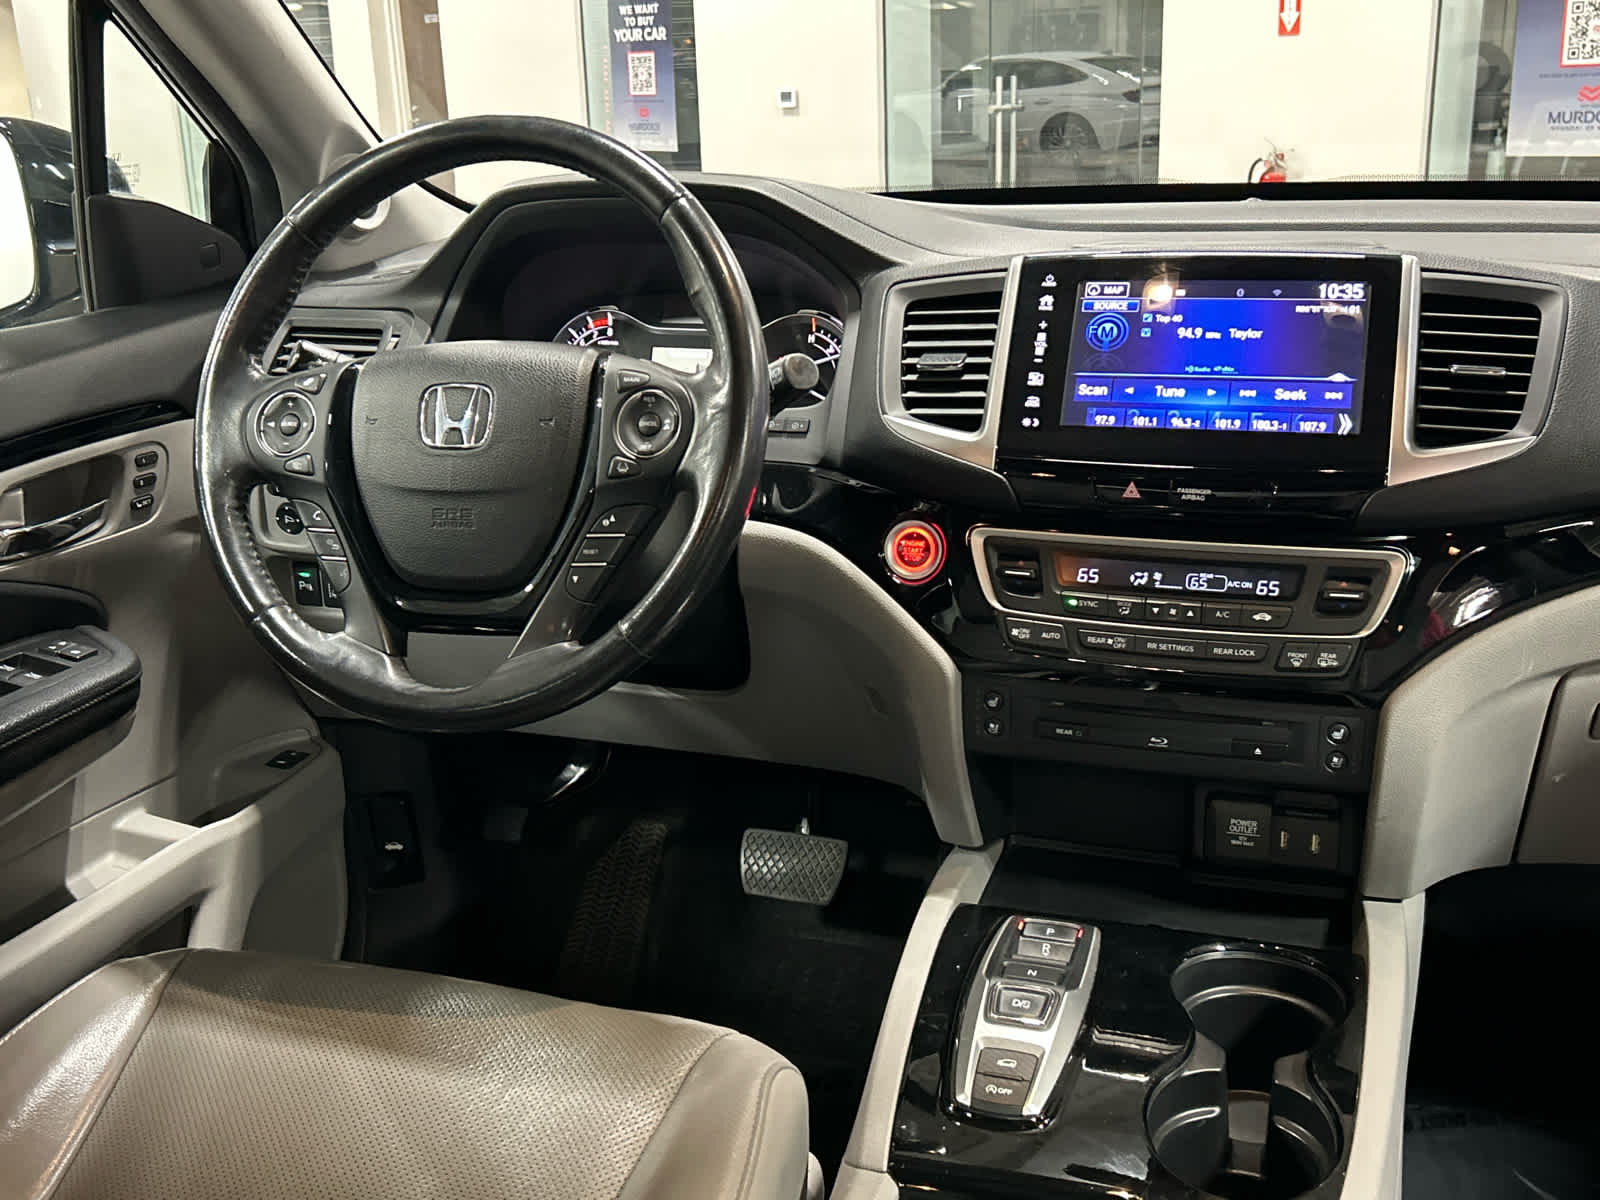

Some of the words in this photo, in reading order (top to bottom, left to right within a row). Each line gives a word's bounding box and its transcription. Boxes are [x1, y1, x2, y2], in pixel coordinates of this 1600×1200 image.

[619, 5, 633, 15] WE
[634, 3, 659, 14] WANT
[624, 17, 636, 26] TO
[637, 16, 654, 26] BUY
[614, 28, 643, 42] YOUR
[644, 27, 667, 41] CAR
[1103, 286, 1124, 295] MAP
[1319, 282, 1365, 299] 10:35
[1093, 302, 1128, 311] SOURCE
[1155, 314, 1170, 324] Top
[1171, 314, 1183, 323] 40
[1177, 328, 1202, 339] 94.9
[1229, 328, 1263, 341] Taylor
[1078, 384, 1108, 396] Scan
[1155, 385, 1186, 398] Tune
[1274, 388, 1307, 401] Seek
[1094, 414, 1115, 425] 97.9
[1132, 416, 1158, 427] 101.1
[1214, 418, 1241, 429] 101.9
[1299, 421, 1327, 432] 107.9
[1176, 487, 1212, 495] PASSENGER
[1077, 568, 1099, 583] 65
[1190, 577, 1208, 589] 65
[1227, 580, 1240, 588] A/C
[1256, 580, 1280, 596] 65
[1079, 600, 1098, 608] SYNC
[1088, 636, 1106, 644] REAR
[1147, 642, 1157, 650] RR
[1158, 643, 1194, 653] SETTINGS
[1213, 647, 1233, 656] REAR
[1234, 648, 1255, 657] LOCK
[1230, 818, 1257, 827] POWER
[1229, 825, 1257, 834] OUTLET
[1046, 928, 1055, 936] P
[1011, 998, 1031, 1009] D/S
[998, 1087, 1013, 1095] OFF
